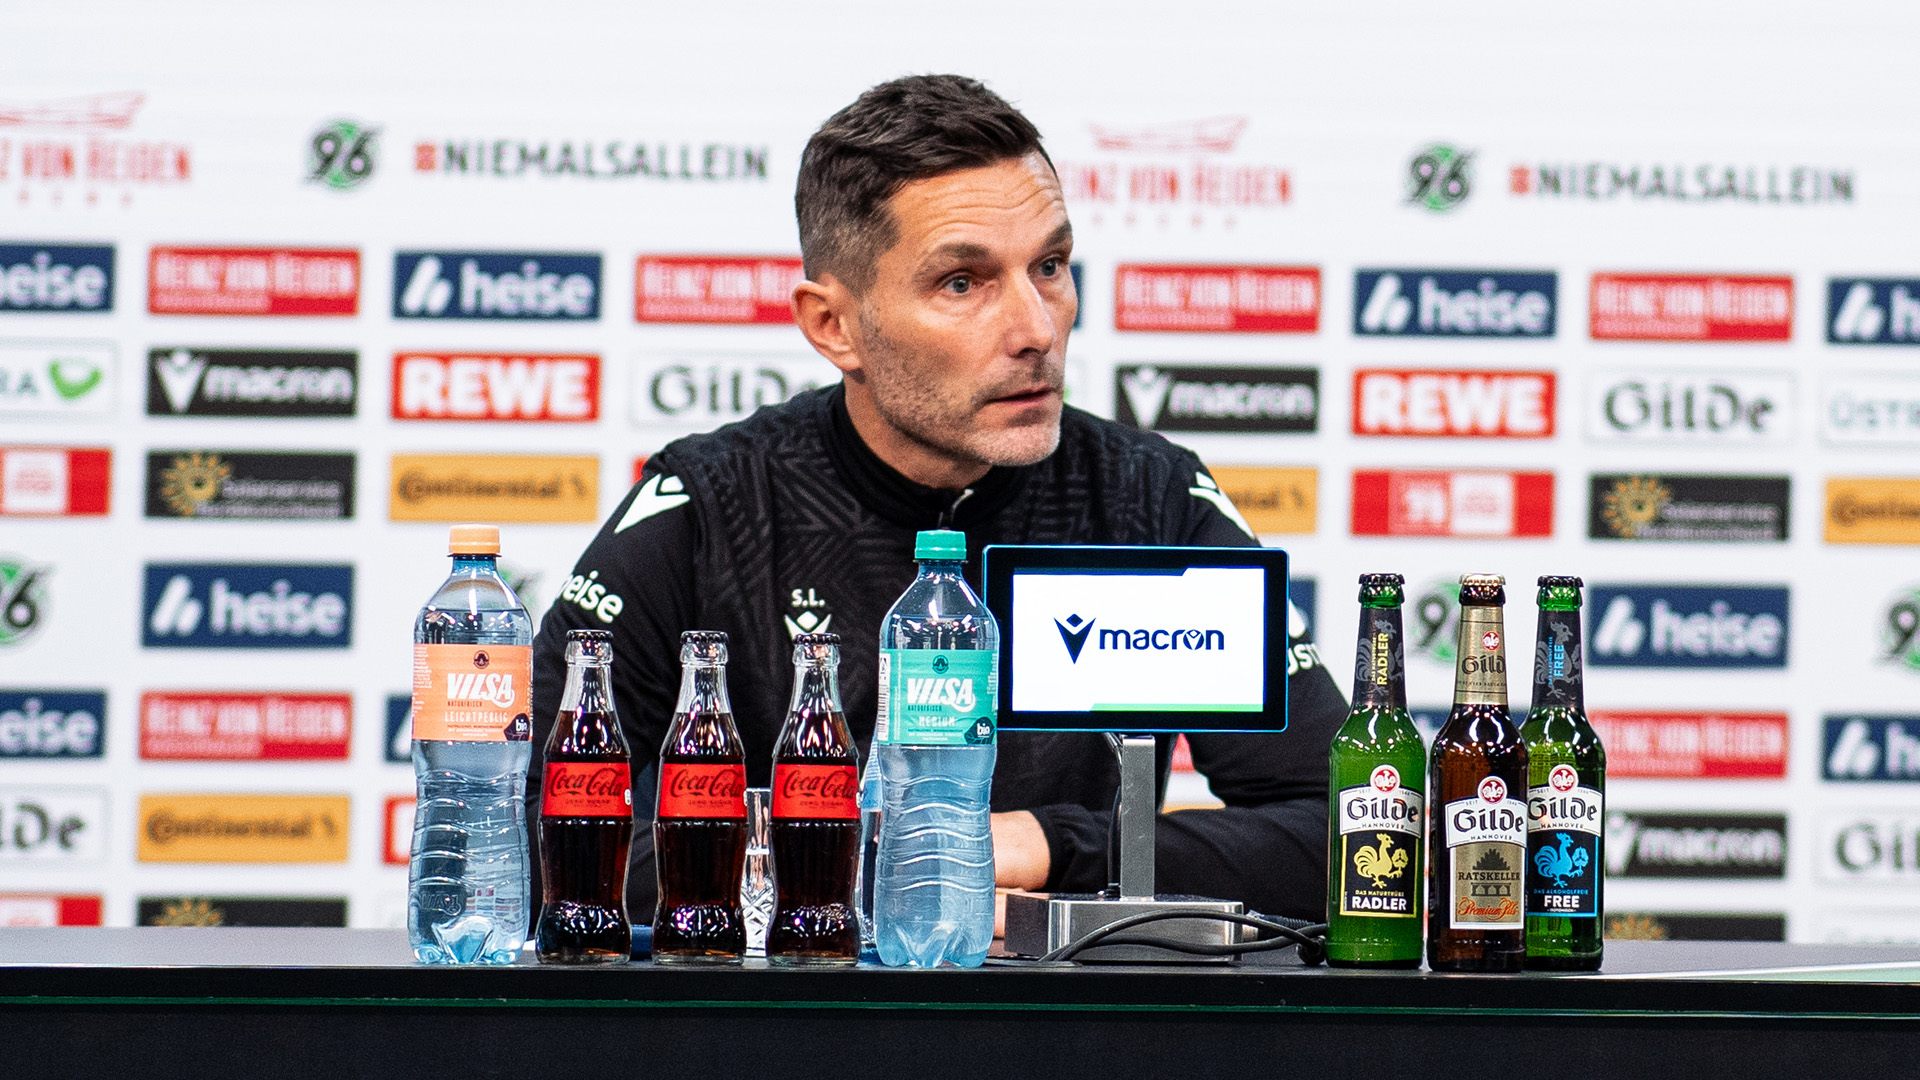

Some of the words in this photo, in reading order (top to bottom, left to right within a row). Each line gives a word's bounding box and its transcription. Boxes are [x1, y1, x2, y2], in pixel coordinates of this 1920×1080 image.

[304, 117, 382, 185] 96
[1405, 147, 1475, 208] 96
[460, 260, 597, 316] heise
[1418, 276, 1549, 334] heise
[202, 364, 354, 401] macron
[401, 357, 591, 417] REWE
[649, 364, 820, 416] Gild
[1169, 382, 1316, 420] macron
[1361, 373, 1547, 431] REWE
[1604, 380, 1774, 434] Gilde
[0, 568, 50, 630] 6
[210, 578, 347, 637] heise
[790, 587, 826, 608] S.L.
[1099, 628, 1225, 651] macron
[1652, 598, 1783, 658] heise
[1874, 601, 1920, 664] 9
[1376, 632, 1389, 686] RADLER
[1461, 654, 1506, 675] Gild
[1553, 644, 1565, 677] FREE
[446, 672, 516, 709] VILSA
[906, 677, 977, 713] VILSA
[0, 697, 98, 751] eise
[976, 722, 991, 736] bio
[551, 767, 624, 797] Coca-Cola
[670, 768, 744, 798] Coca-Cola
[783, 769, 856, 799] Coca-Cola
[1346, 796, 1420, 823] Gilde
[1361, 822, 1405, 830] HANNOVER
[1453, 808, 1525, 833] Gilde
[1527, 796, 1598, 822] Gilde
[1470, 833, 1513, 841] HANNOVER
[1637, 826, 1783, 867] macron
[1458, 871, 1521, 881] RATSKELLER
[1351, 895, 1407, 911] RADLER
[1457, 896, 1501, 917] Premium
[1543, 894, 1581, 909] FREE
